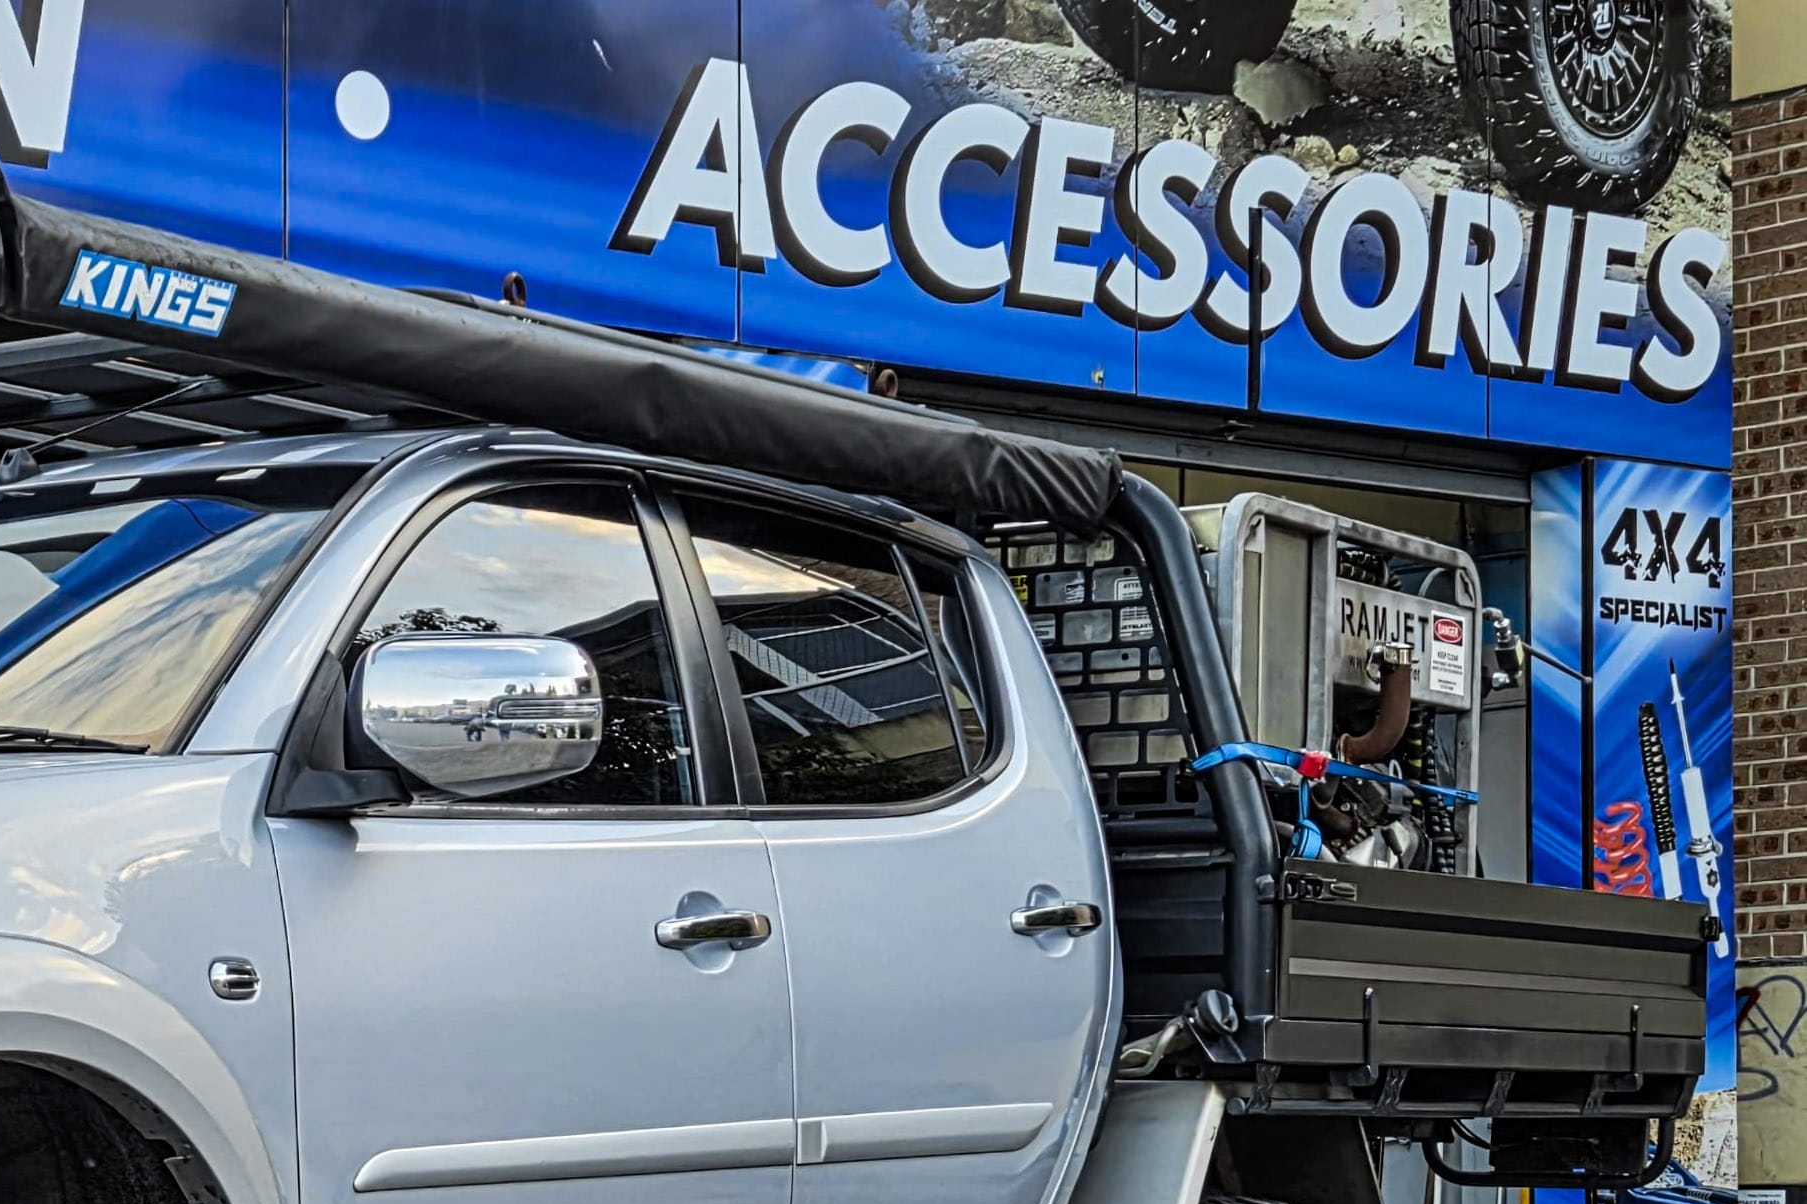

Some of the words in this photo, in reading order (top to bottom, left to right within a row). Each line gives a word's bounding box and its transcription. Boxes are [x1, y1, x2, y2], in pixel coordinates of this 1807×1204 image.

[627, 56, 1728, 394] ACCESSORIES
[66, 256, 232, 332] KINGS
[1341, 597, 1429, 653] RAMJET
[1599, 597, 1727, 633] SPECIALIST
